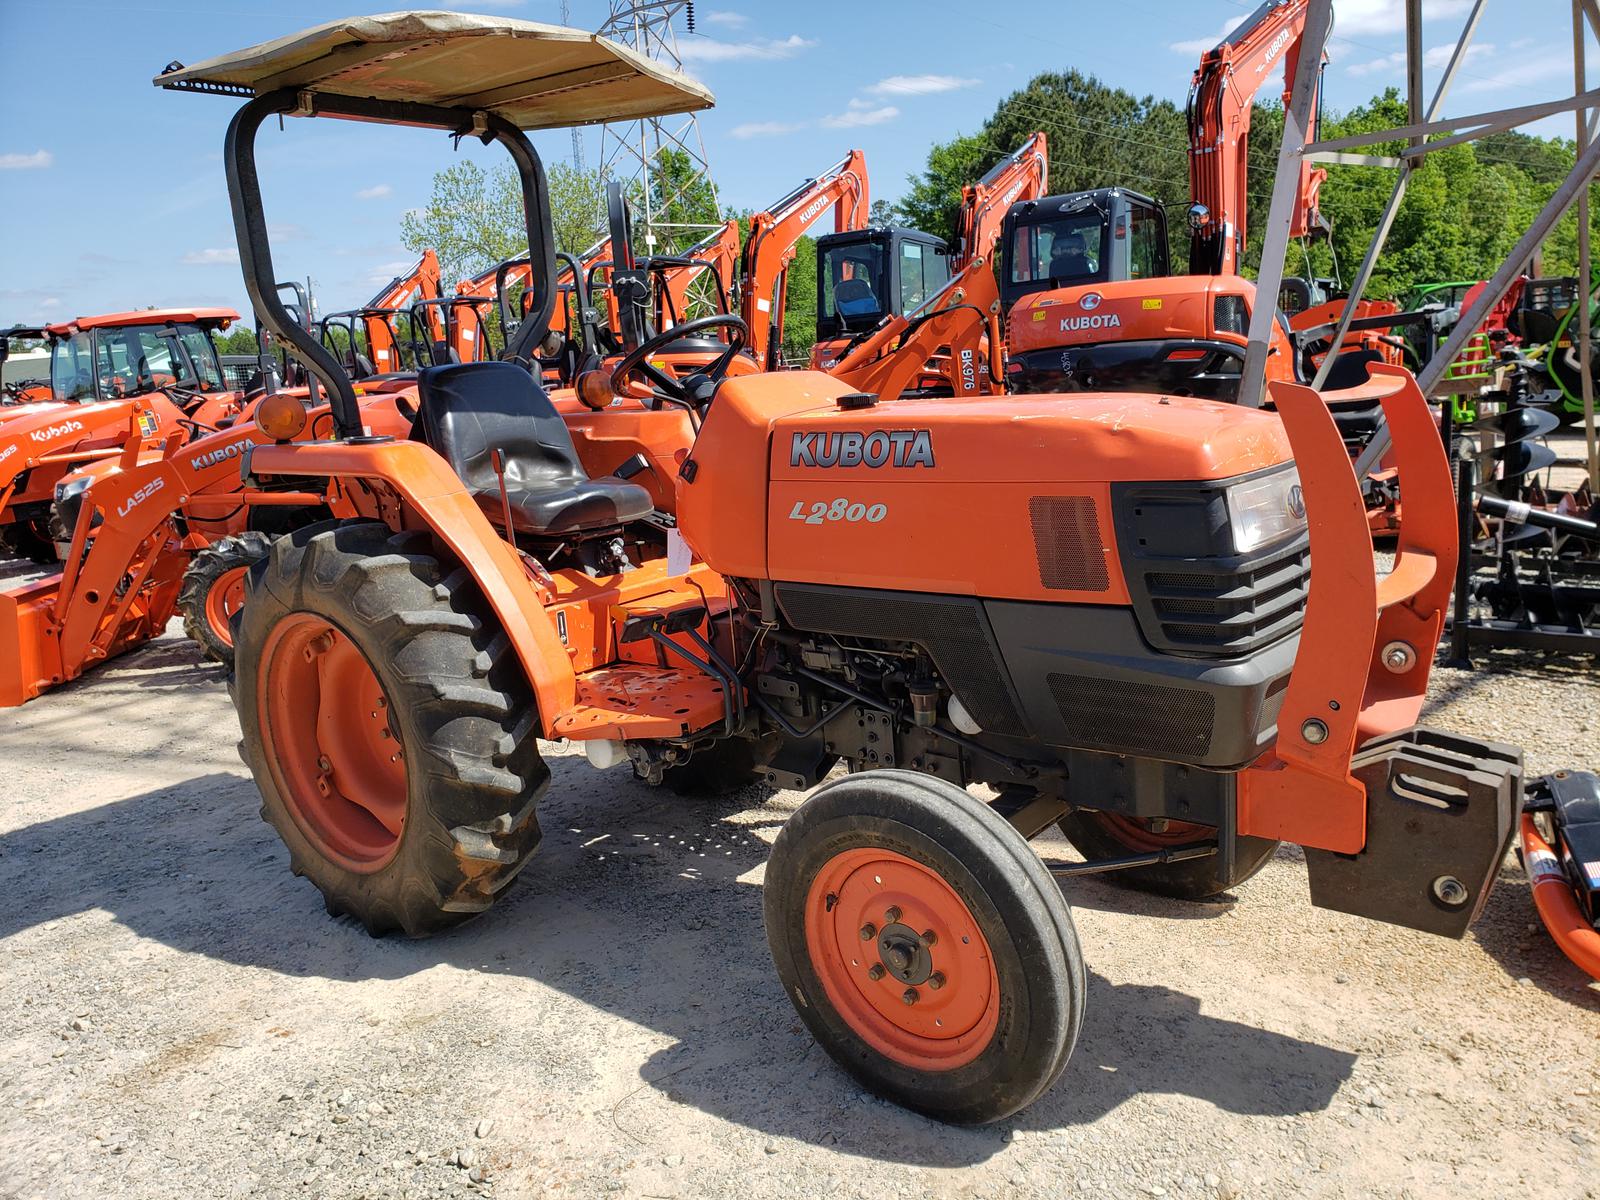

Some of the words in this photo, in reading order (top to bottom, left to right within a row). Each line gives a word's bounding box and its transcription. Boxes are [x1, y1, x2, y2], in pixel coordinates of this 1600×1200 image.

[1264, 28, 1290, 63] KUBOTA
[799, 194, 829, 224] KUBOTA
[1059, 314, 1121, 332] KUBOTA
[961, 350, 975, 390] BK976
[30, 420, 83, 442] Kubota
[191, 438, 256, 471] KUBOTA
[790, 429, 936, 468] KUBOTA
[117, 476, 165, 518] LA525
[789, 498, 888, 525] L2800
